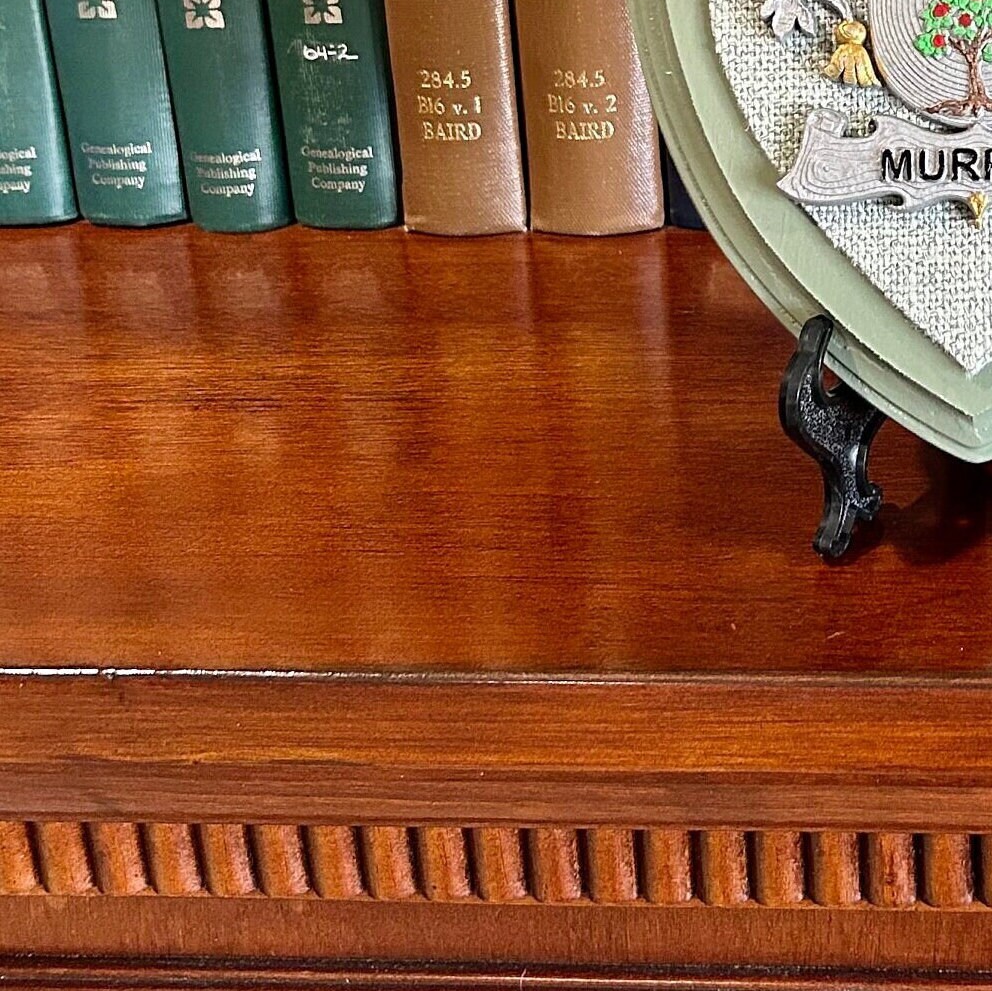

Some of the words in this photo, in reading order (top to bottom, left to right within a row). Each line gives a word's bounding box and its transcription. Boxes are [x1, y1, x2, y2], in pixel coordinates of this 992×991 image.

[420, 70, 472, 88] 284.5
[554, 70, 606, 88] 284.5
[452, 104, 468, 115] v.
[606, 94, 617, 113] 2
[423, 121, 482, 141] BAIRD
[556, 120, 615, 141] BAIRD
[81, 142, 152, 158] Genealogical
[190, 149, 262, 167] Genealogical
[301, 146, 374, 161] Genealogical
[89, 159, 147, 172] Publishing
[197, 167, 257, 180] Publishing
[308, 162, 367, 177] Publishing
[92, 174, 145, 189] Company
[312, 177, 365, 193] Company
[201, 183, 254, 197] Company
